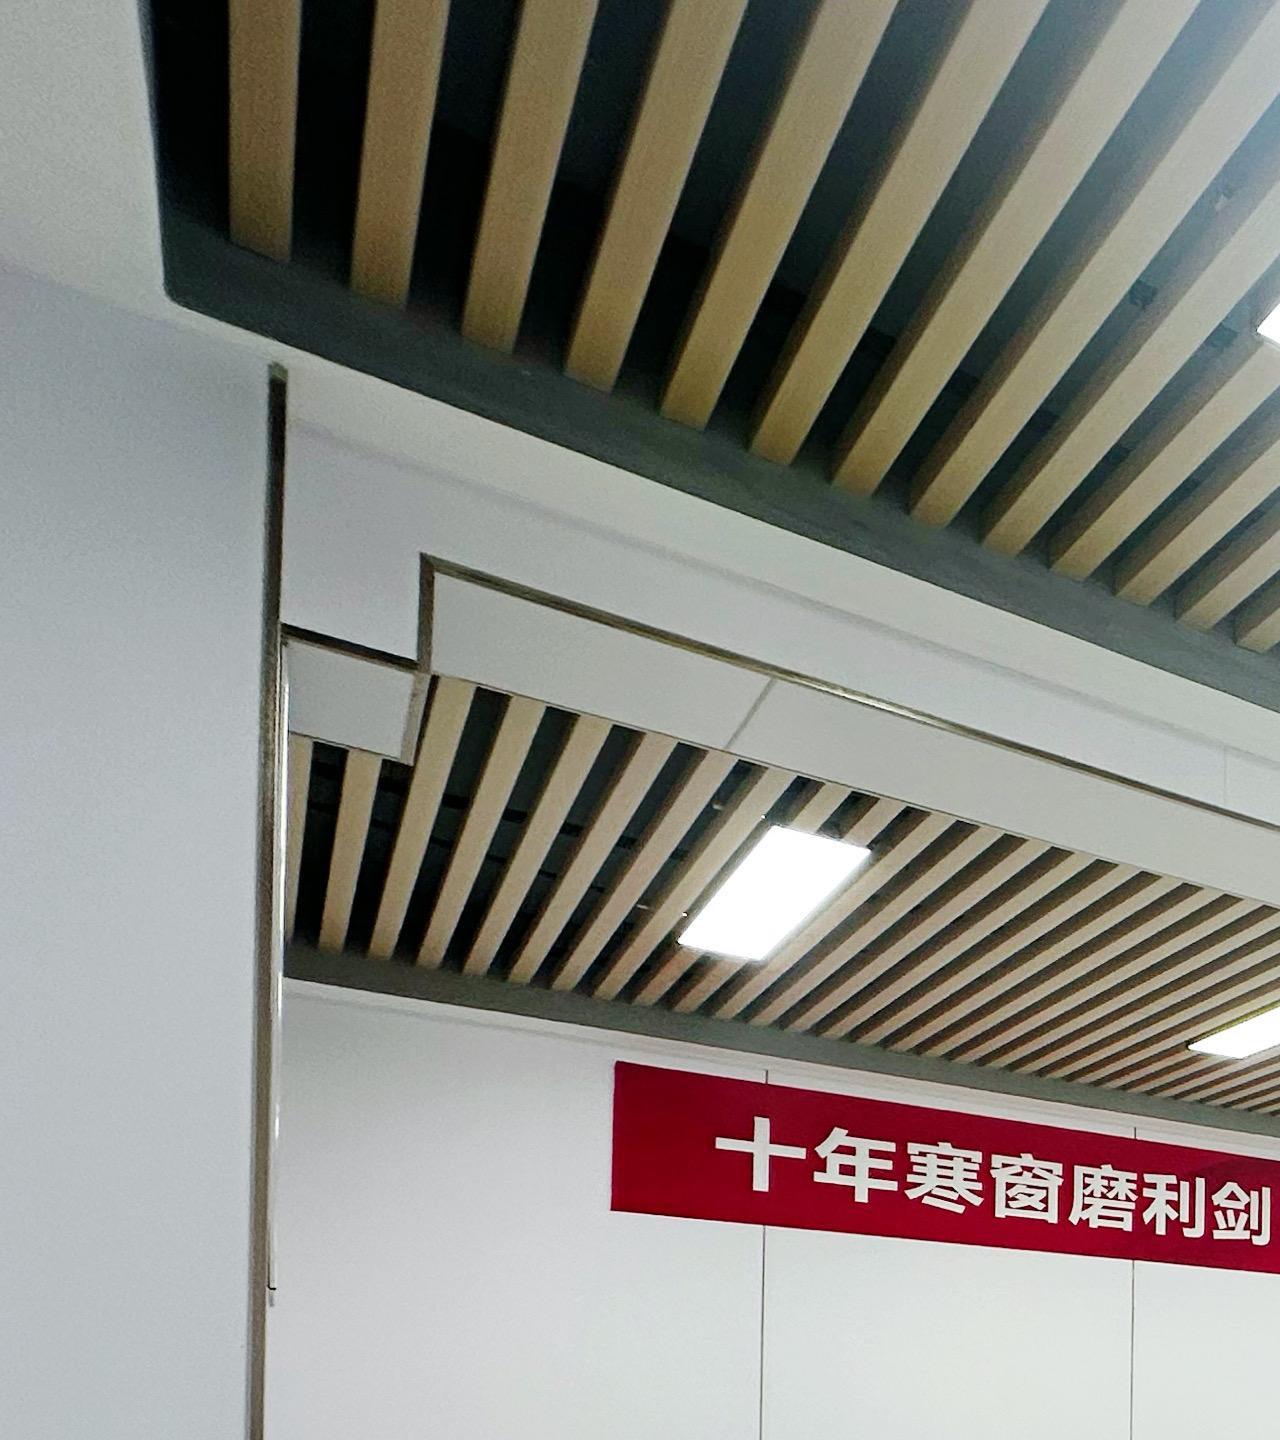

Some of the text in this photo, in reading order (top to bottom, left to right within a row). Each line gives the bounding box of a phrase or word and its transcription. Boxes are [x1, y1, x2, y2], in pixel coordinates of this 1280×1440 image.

[715, 1116, 1271, 1246] 十年寒窗磨利剑
